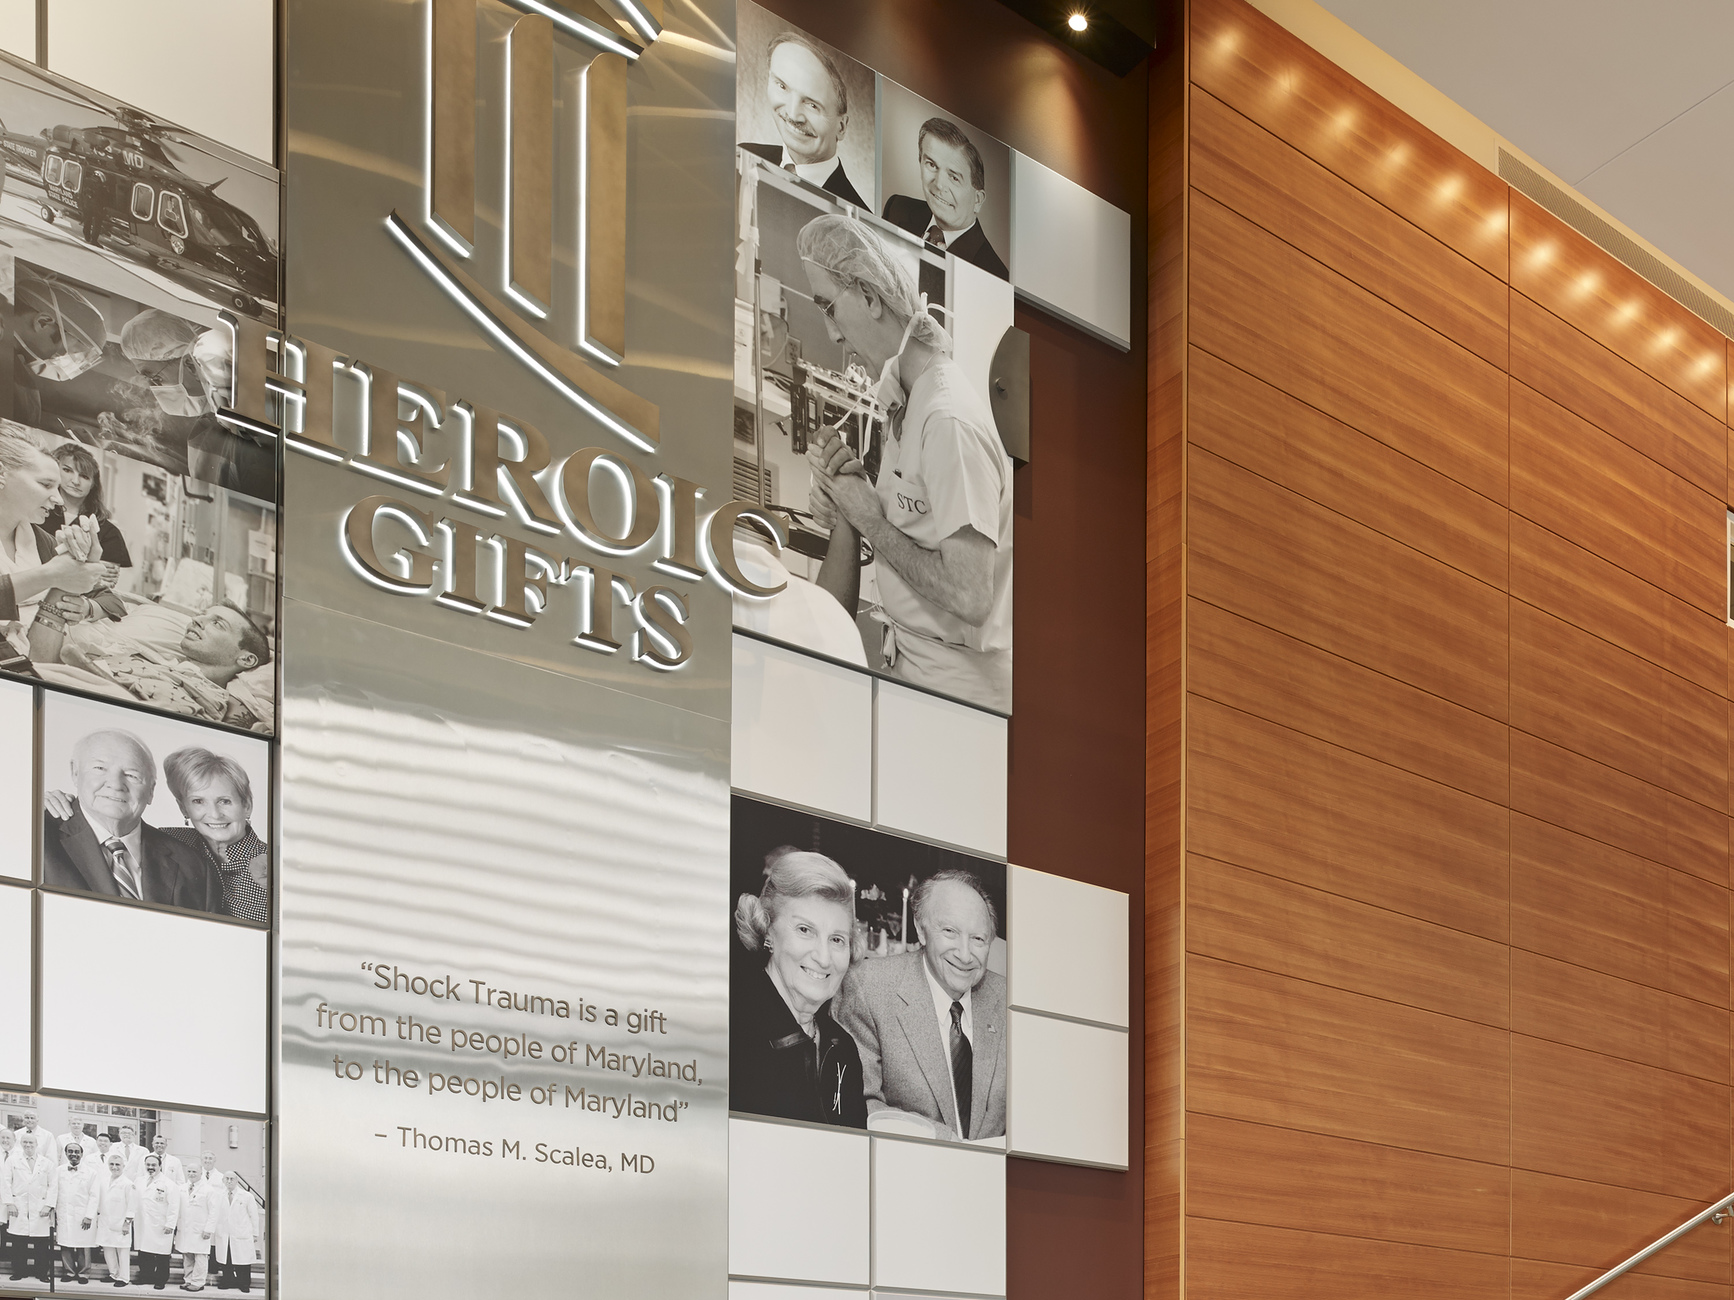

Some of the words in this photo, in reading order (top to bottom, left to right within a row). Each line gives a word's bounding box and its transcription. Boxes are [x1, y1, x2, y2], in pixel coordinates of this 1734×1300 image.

[15, 143, 37, 158] TROOPER
[215, 309, 789, 598] HEROIC
[897, 491, 928, 515] STC
[343, 495, 694, 670] GIFTS
[361, 961, 461, 1001] “Shock
[469, 979, 571, 1019] Trauma
[579, 997, 597, 1022] is
[605, 1005, 618, 1026] a
[627, 1009, 668, 1035] gift
[316, 1002, 387, 1037] from
[396, 1015, 442, 1044] the
[451, 1027, 543, 1060] people
[551, 1041, 578, 1065] of
[586, 1043, 704, 1087] Maryland,
[333, 1054, 363, 1081] to
[373, 1059, 419, 1088] the
[428, 1071, 522, 1102] people
[530, 1083, 557, 1106] of
[565, 1084, 689, 1122] Maryland”
[397, 1126, 493, 1156] Thomas
[502, 1139, 527, 1161] M.
[534, 1143, 613, 1173] Scalea,
[620, 1153, 655, 1174] MD
